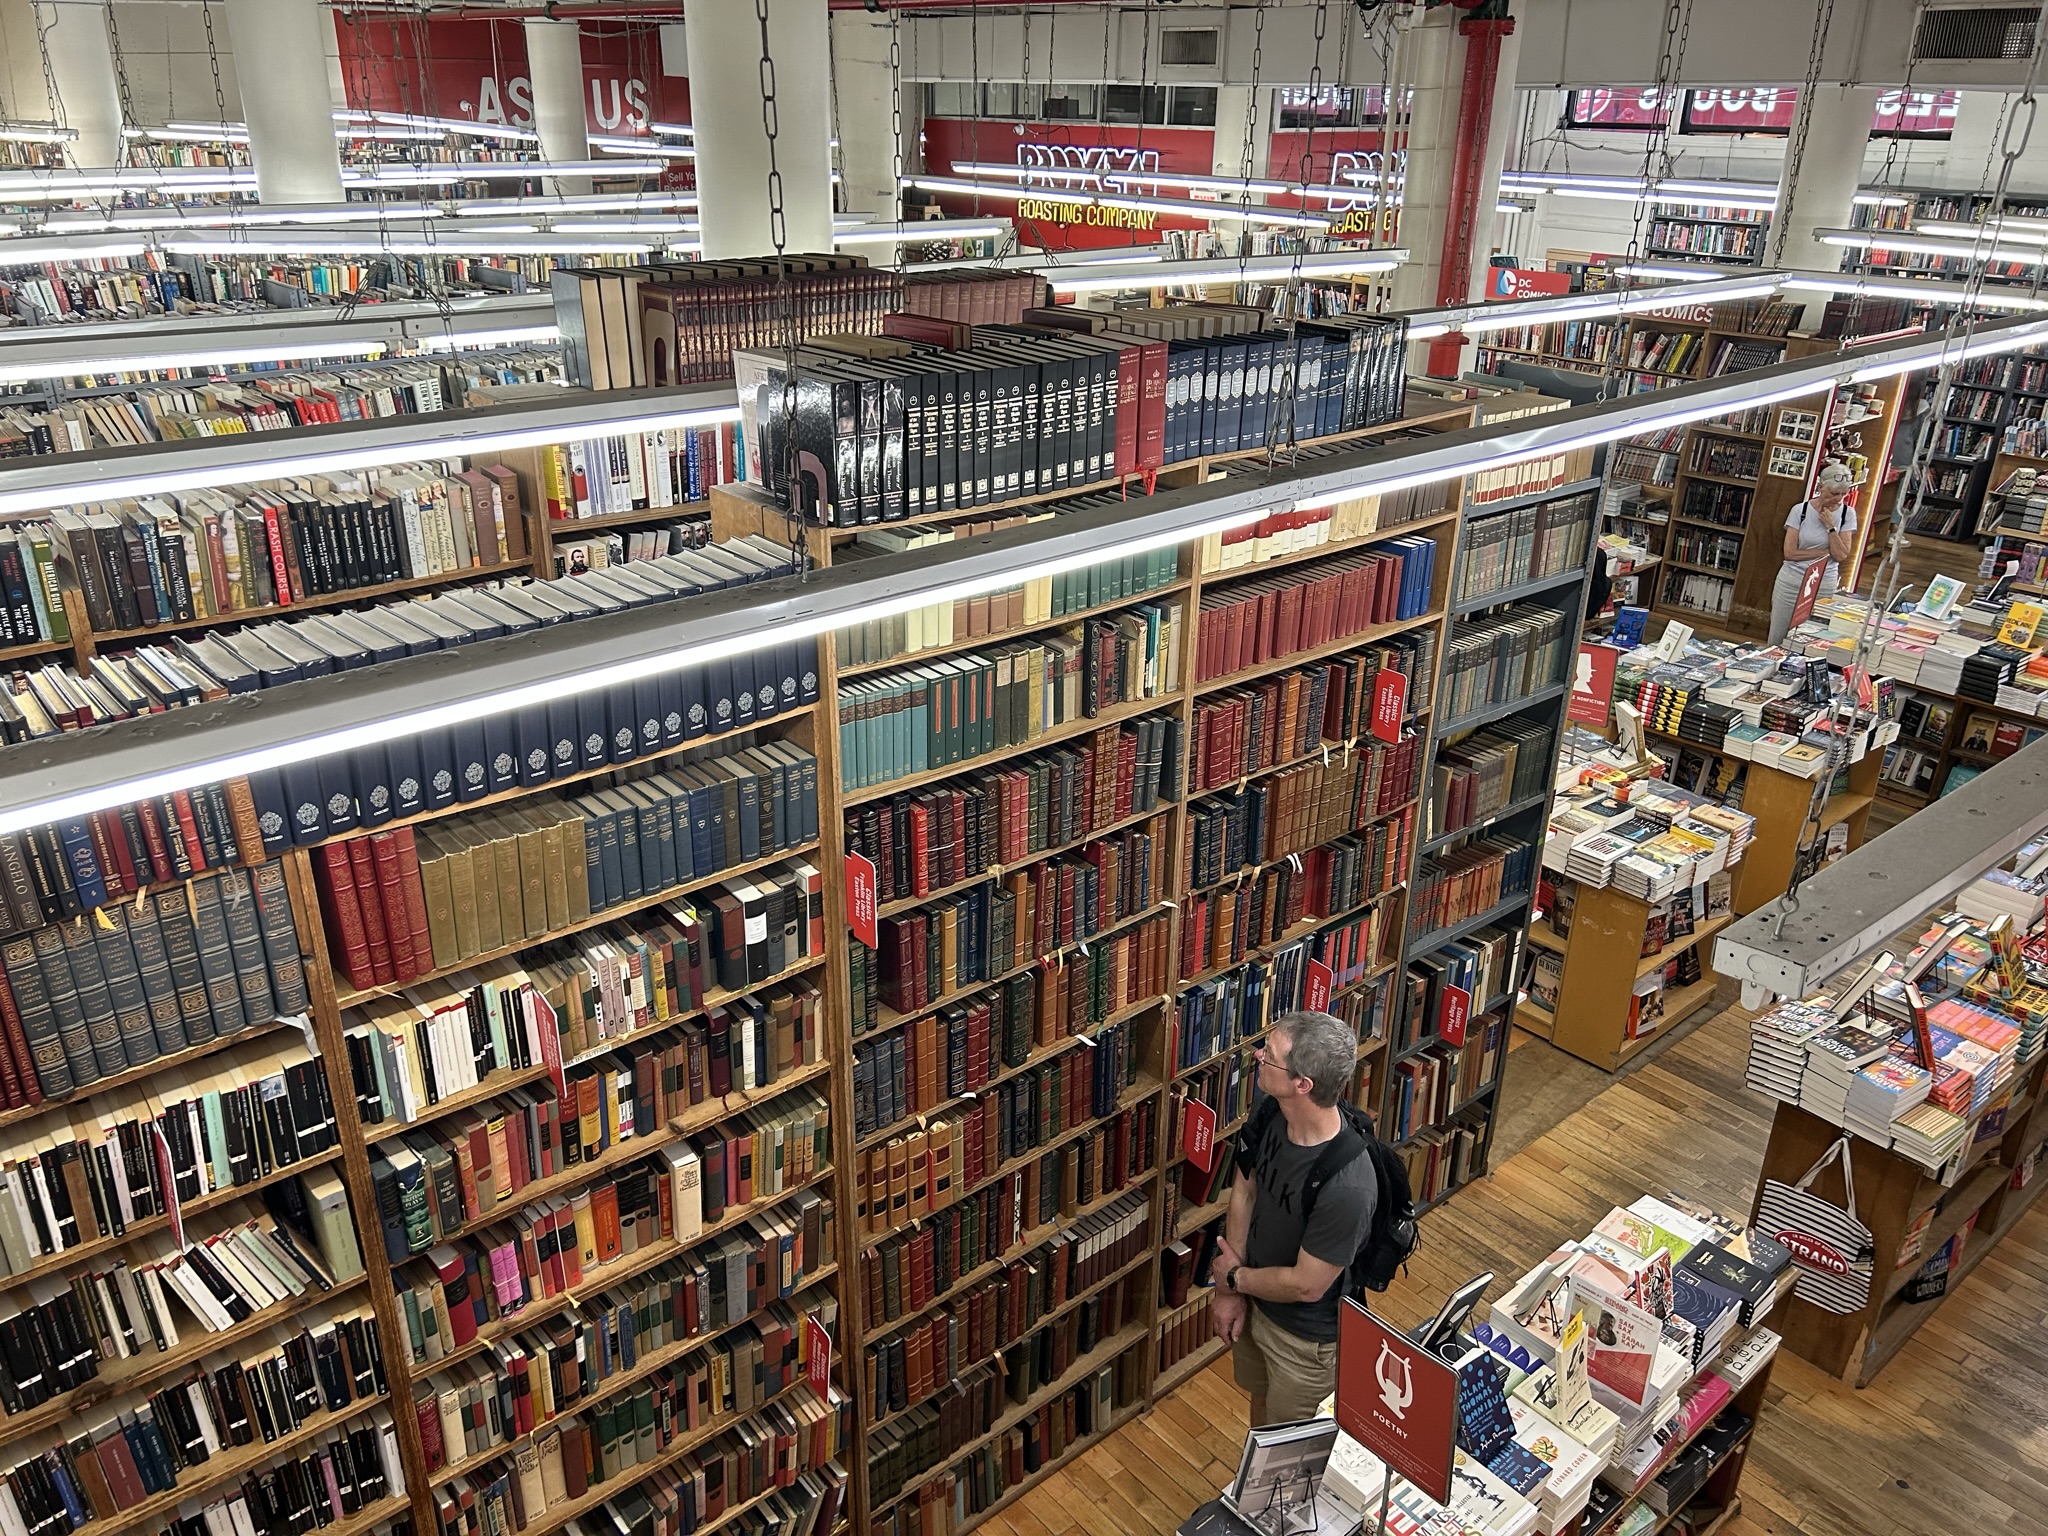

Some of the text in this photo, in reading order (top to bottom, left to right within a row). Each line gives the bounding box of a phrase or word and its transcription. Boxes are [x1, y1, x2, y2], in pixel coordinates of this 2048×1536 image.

[478, 76, 650, 130] AS US
[668, 172, 684, 183] Sell
[1018, 199, 1157, 231] ROASTING COMPANY
[1518, 279, 1532, 288] DC
[1652, 305, 1714, 322] COMICS
[420, 380, 429, 399] LEON
[431, 380, 440, 398] LEON
[1370, 386, 1378, 411] MUSIC
[1346, 390, 1354, 416] MUSIC
[330, 529, 338, 547] Benjamin
[144, 538, 152, 563] America
[153, 547, 163, 578] Dangerous
[267, 518, 289, 594] CRASH COURSE
[81, 554, 96, 602] Benjamin Franklin
[109, 550, 124, 598] Benjamin Franklin
[168, 549, 184, 608] POLITICAL THOUGHT
[44, 561, 63, 612] AMERICAN GULAG
[177, 574, 188, 606] AMERICAN
[0, 607, 9, 627] BATTLE
[17, 621, 26, 635] SOUL
[21, 604, 35, 636] BATTLE FOR
[1384, 683, 1395, 723] Franklin Library
[1391, 695, 1400, 721] Classics
[1576, 696, 1605, 707] NONFICTION
[165, 803, 177, 827] SEASON
[144, 809, 161, 854] Christmas Book
[48, 830, 70, 890] MAGNUM PHOTOGRAPHERS
[95, 823, 104, 844] HISTORIC
[100, 844, 108, 860] FRONT
[104, 859, 114, 874] PAGES
[0, 836, 28, 895] LANGELO
[27, 835, 50, 896] MAGNUM PHOTOGRAPHERS
[76, 859, 93, 867] PAINE
[25, 901, 37, 923] FOLIO
[601, 963, 610, 992] ISLAM
[612, 961, 621, 990] ISLAM
[1309, 990, 1319, 1011] Society
[1318, 985, 1326, 1009] Classics
[1447, 996, 1458, 1033] Heritage Press
[1455, 1007, 1463, 1029] Classics
[1778, 1010, 1811, 1024] MOON
[1781, 1002, 1829, 1020] BANYAN
[10, 1021, 29, 1071] OMAR KHAYYAM
[575, 1044, 610, 1064] BY AUTHOR
[1815, 1037, 1857, 1061] HOOVER
[1826, 1037, 1857, 1055] COLLEEN
[1933, 1036, 1953, 1055] PEOPLE
[1880, 1060, 1921, 1080] BONES
[1888, 1056, 1927, 1075] HEART
[1862, 1070, 1904, 1092] HOOVER
[1874, 1071, 1901, 1086] COLLEEN
[1194, 1131, 1202, 1153] Society
[1201, 1126, 1210, 1151] Classics
[1779, 1235, 1845, 1274] STRAND
[1799, 1235, 1813, 1244] MILES
[1821, 1244, 1837, 1257] BOOKS
[1604, 1295, 1629, 1314] STRAND
[1617, 1324, 1632, 1336] SAX
[1618, 1318, 1635, 1331] SAM
[1620, 1339, 1636, 1350] KAY
[1621, 1332, 1646, 1350] SARAH
[1458, 1379, 1485, 1403] DYLAN
[1461, 1387, 1493, 1413] THOMAS
[1465, 1390, 1505, 1425] OMNIBUS
[1587, 1403, 1602, 1420] Love
[1373, 1409, 1408, 1440] POETRY
[1551, 1452, 1589, 1489] LEONARD COHEN
